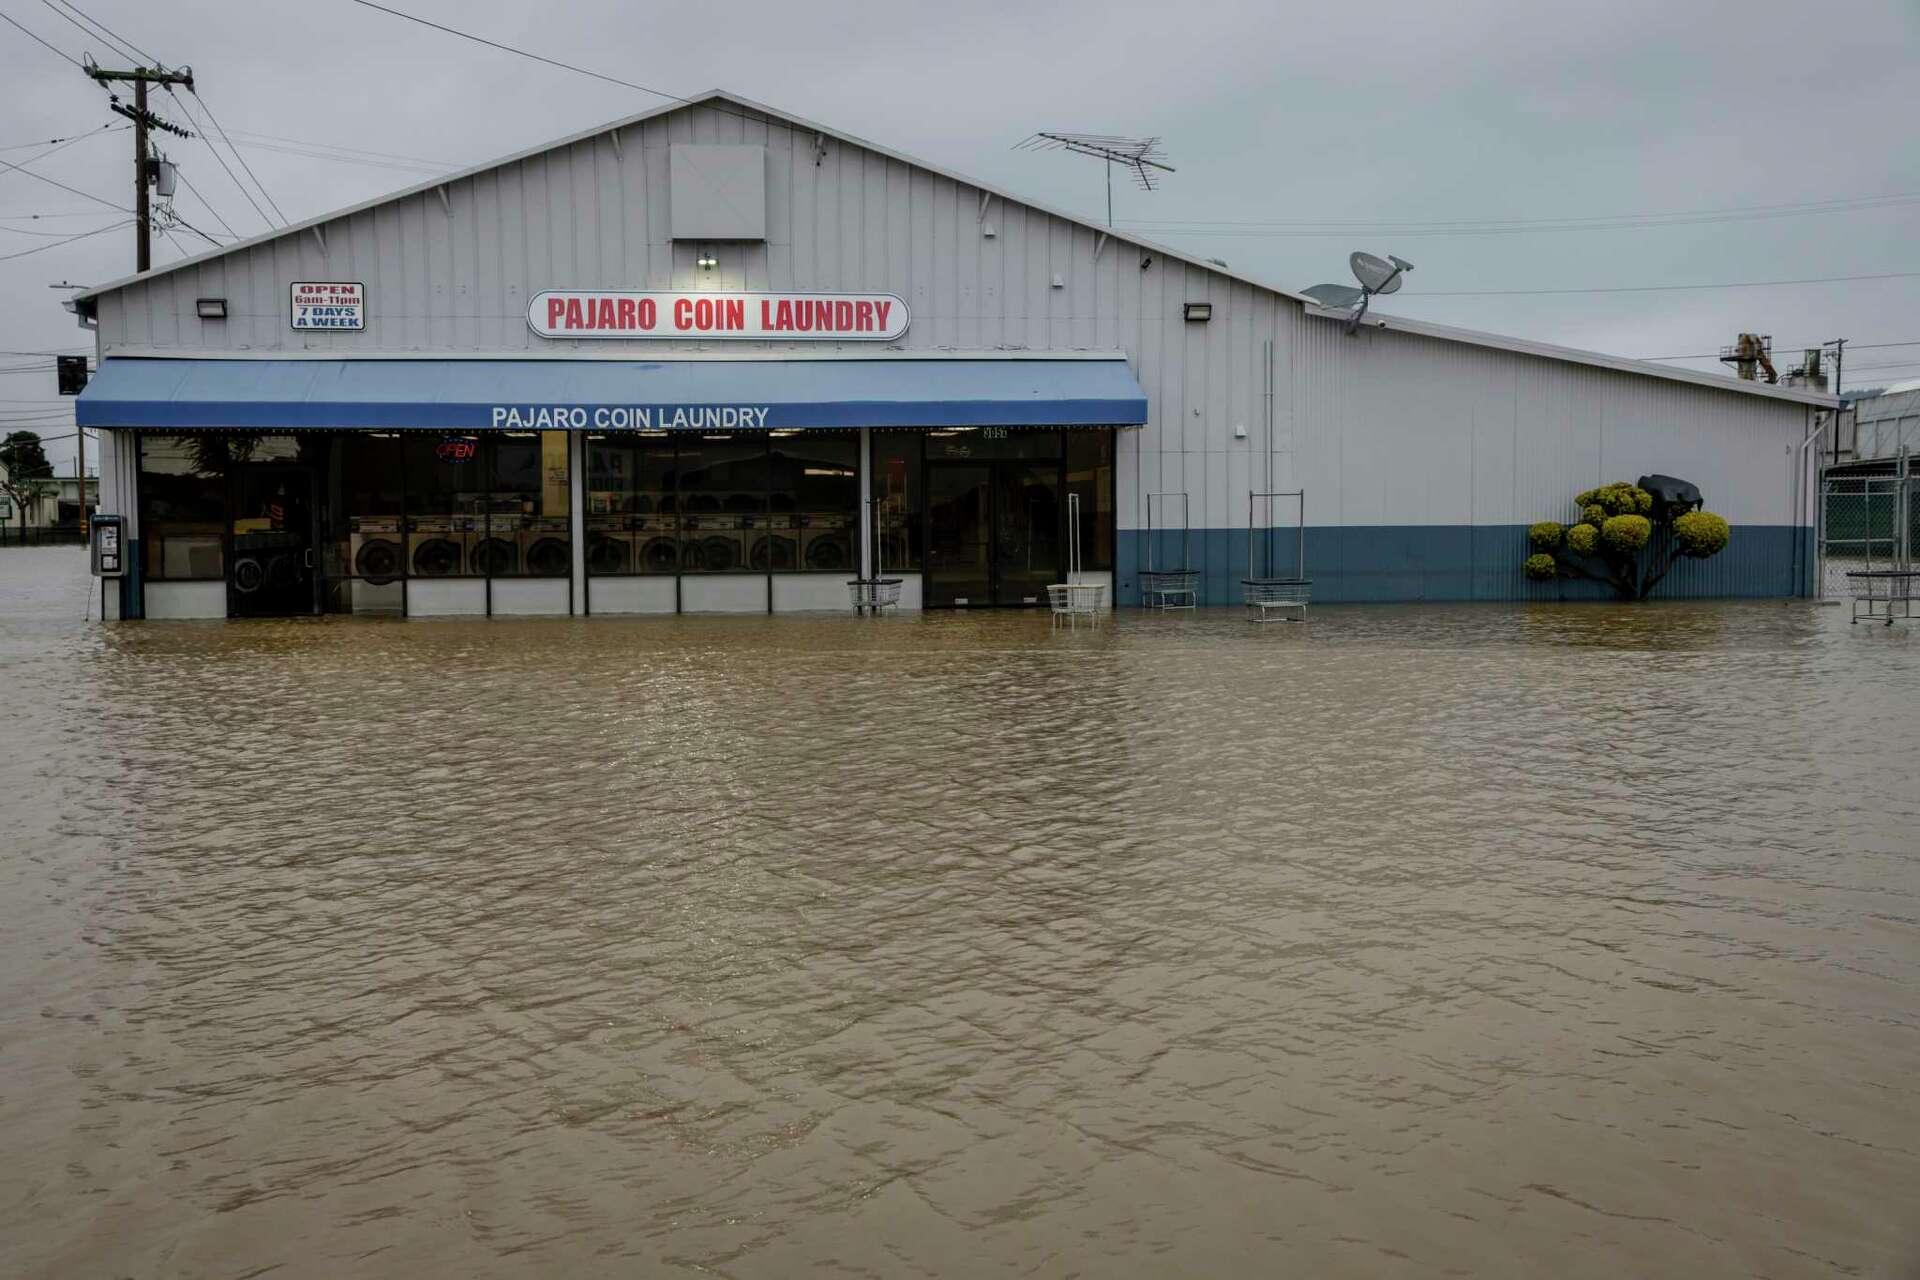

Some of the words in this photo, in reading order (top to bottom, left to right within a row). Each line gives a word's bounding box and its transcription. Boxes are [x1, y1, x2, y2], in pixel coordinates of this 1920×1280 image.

[300, 285, 355, 294] OPEN
[300, 307, 308, 316] 7
[312, 307, 355, 316] DAYS
[547, 298, 657, 331] PAJARO
[674, 299, 745, 332] COIN
[761, 299, 892, 333] LAUNDRY
[297, 317, 308, 327] A
[312, 317, 360, 327] WEEK
[492, 407, 588, 429] PAJARO
[594, 408, 651, 429] COIN
[659, 408, 769, 429] LAUNDRY
[436, 443, 475, 458] OPEN
